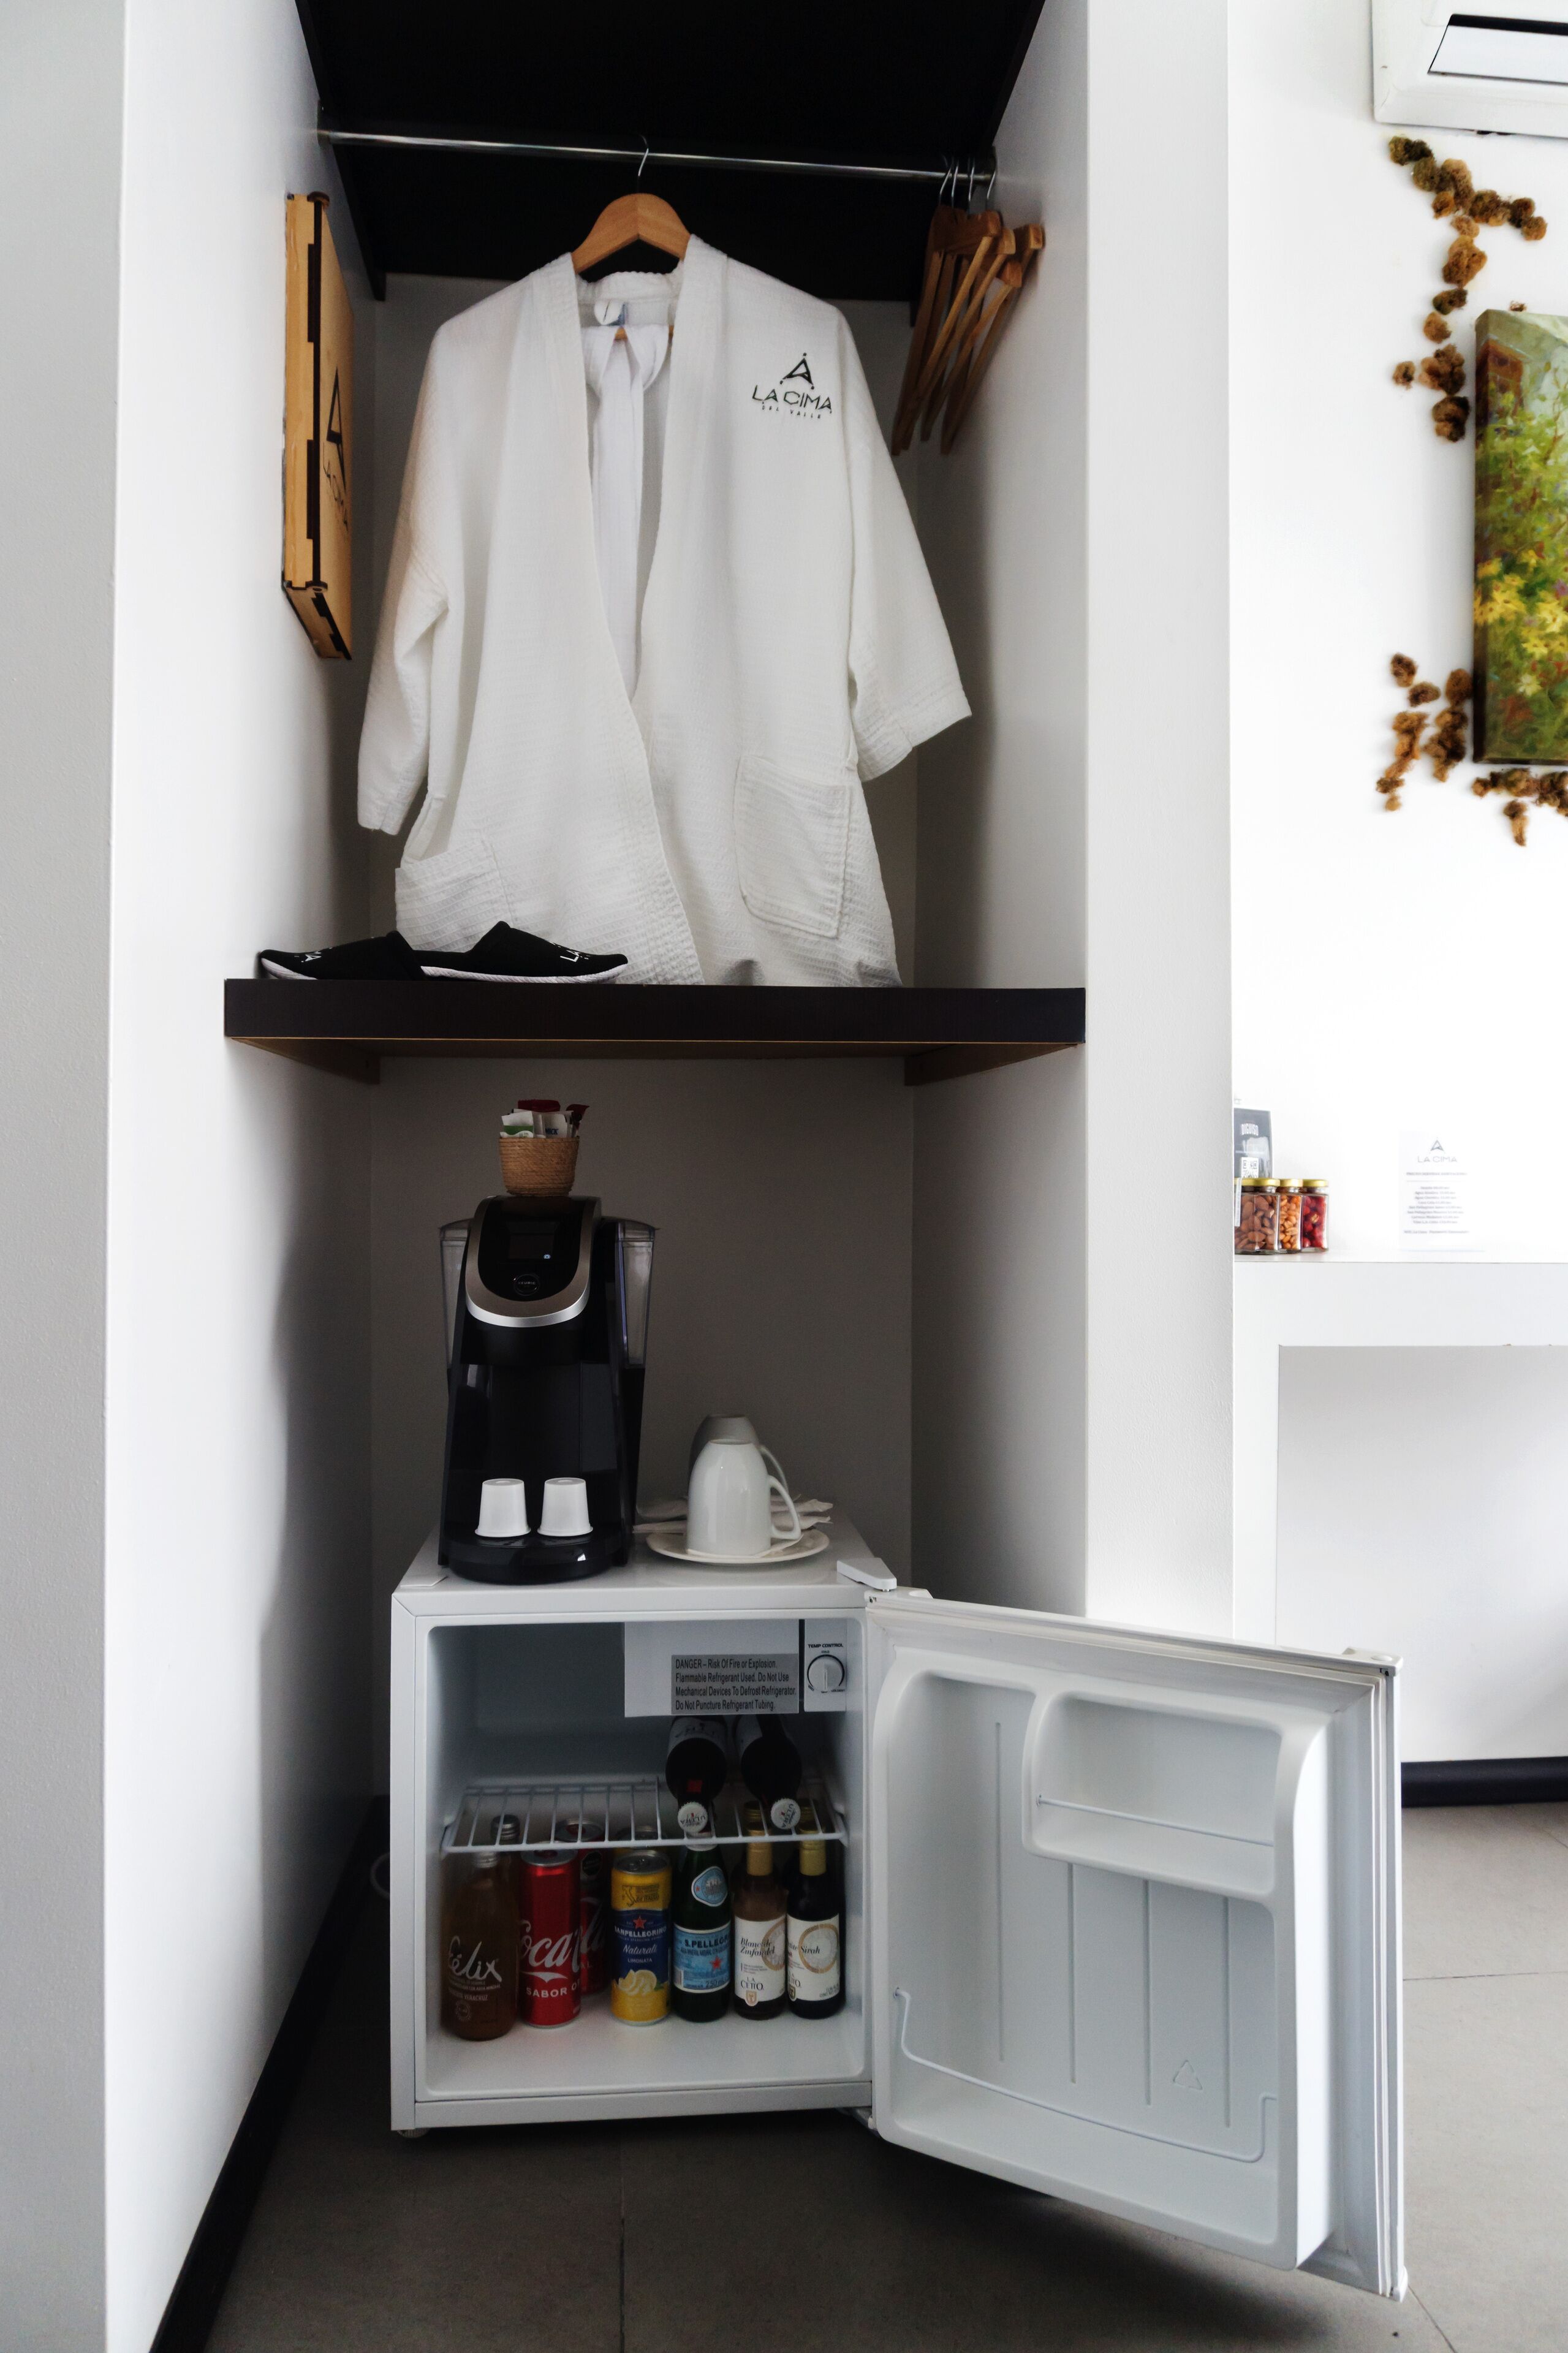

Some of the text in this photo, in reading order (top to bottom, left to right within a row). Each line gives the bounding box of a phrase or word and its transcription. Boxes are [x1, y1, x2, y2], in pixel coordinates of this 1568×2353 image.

[752, 384, 832, 410] LA CIMA
[675, 1659, 702, 1669] DANGER
[708, 1659, 720, 1669] Risk
[721, 1659, 729, 1669] Of
[729, 1659, 740, 1669] Fire
[675, 1673, 706, 1683] Flammable
[708, 1672, 740, 1684] Refrigerant
[758, 1672, 766, 1682] Do
[767, 1672, 776, 1682] Not
[778, 1672, 789, 1682] Use
[675, 1686, 708, 1696] Mechanical
[708, 1686, 732, 1696] Devices
[732, 1686, 739, 1696] To
[740, 1686, 760, 1696] Defrost
[762, 1686, 797, 1697] Refrigerator.
[675, 1700, 684, 1710] Do
[684, 1700, 695, 1710] Not
[695, 1700, 721, 1710] Puncture
[722, 1699, 754, 1711] Refrigerant
[740, 1946, 775, 1958] Zinfandel
[801, 1946, 820, 1955] Sirah
[526, 1987, 568, 1998] SABOR
